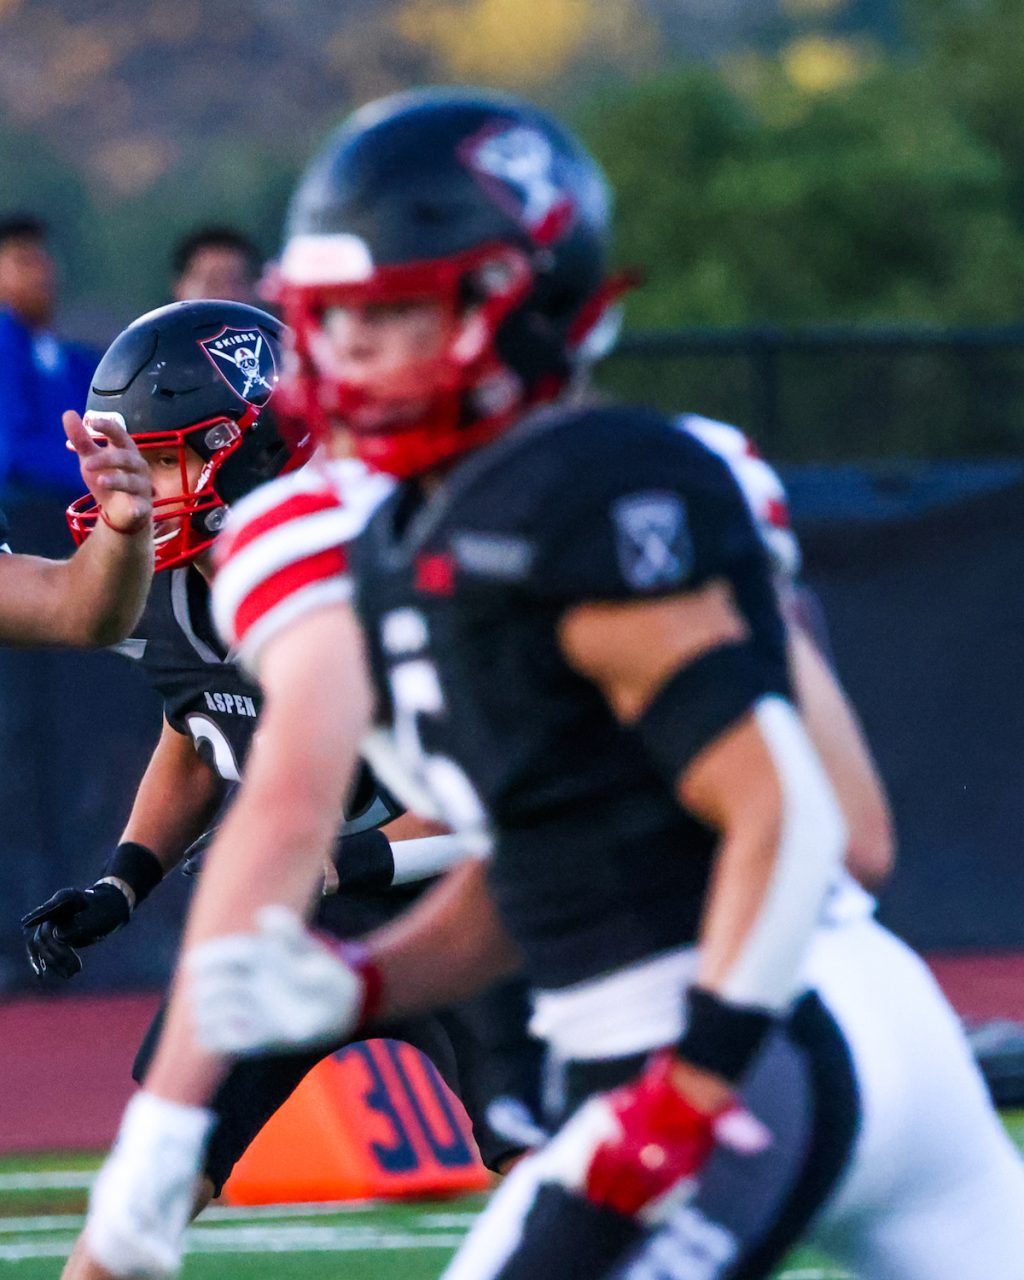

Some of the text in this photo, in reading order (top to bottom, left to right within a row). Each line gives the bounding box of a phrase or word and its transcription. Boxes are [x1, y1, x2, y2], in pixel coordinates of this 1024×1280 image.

[214, 332, 257, 350] SKIERS
[203, 691, 257, 718] ASPEN
[333, 1038, 474, 1173] 30
